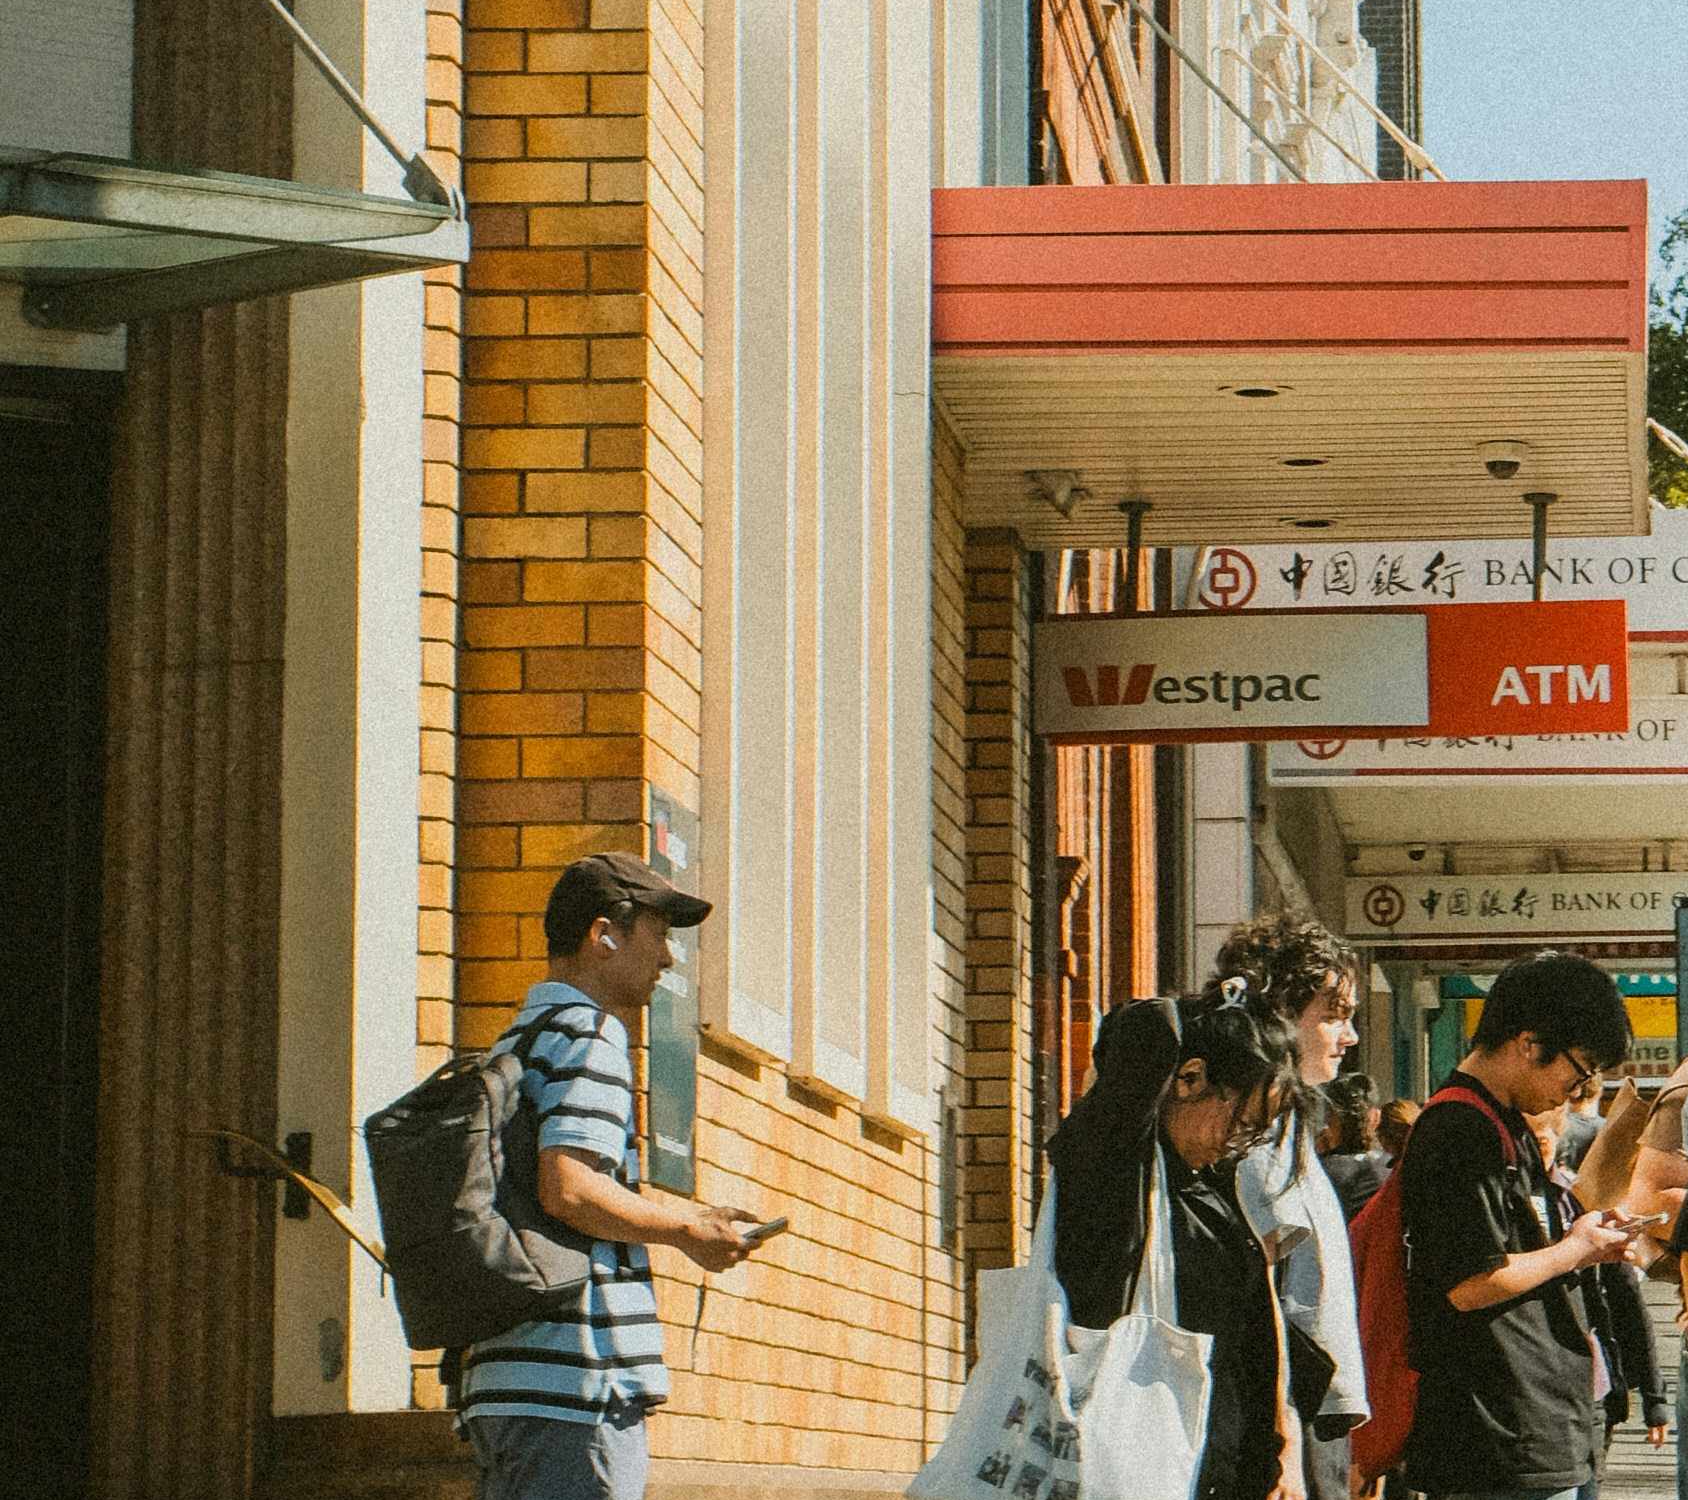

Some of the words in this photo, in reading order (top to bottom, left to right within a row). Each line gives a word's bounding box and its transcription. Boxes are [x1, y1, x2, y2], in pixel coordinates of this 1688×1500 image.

[1484, 557, 1594, 586] BANK
[1608, 557, 1656, 585] OF
[1062, 664, 1321, 711] Westpac
[1491, 664, 1611, 706] ATM
[1637, 719, 1677, 741] OF
[1551, 892, 1623, 912] BANK
[1630, 891, 1664, 910] OF
